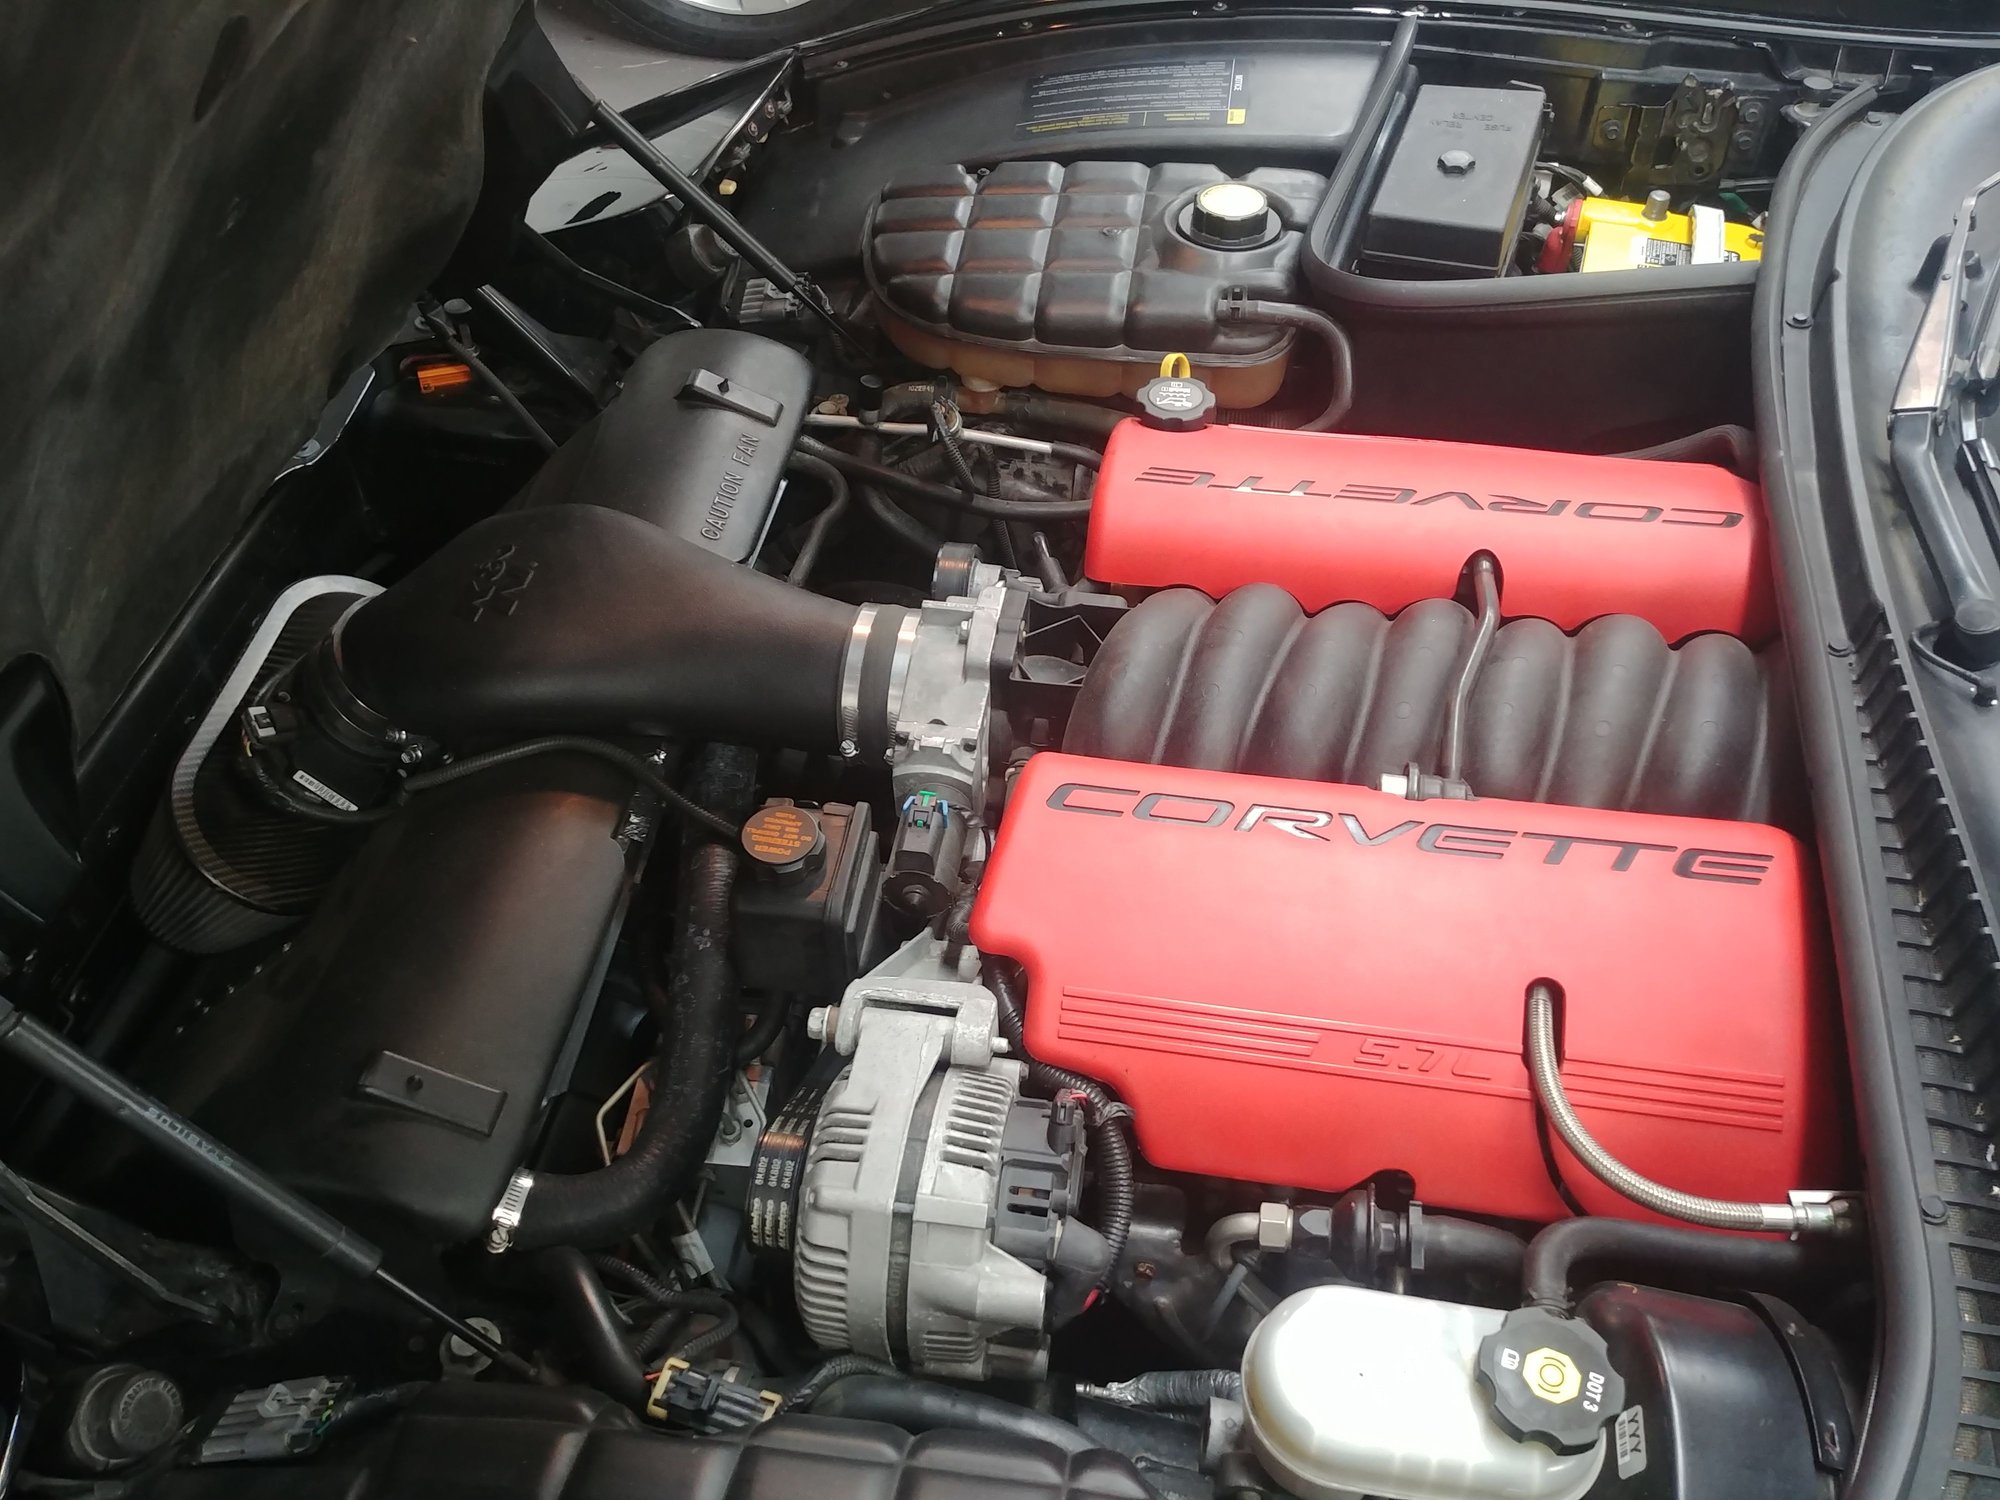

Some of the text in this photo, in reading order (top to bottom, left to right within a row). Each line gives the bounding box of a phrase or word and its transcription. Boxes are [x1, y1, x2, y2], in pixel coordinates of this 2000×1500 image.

[700, 432, 760, 541] CAUTION FAN
[1134, 466, 1745, 528] CORVETTE
[751, 834, 801, 848] STEERING
[753, 844, 792, 856] POWER
[1047, 782, 1775, 886] CORVETTE
[1354, 1038, 1491, 1081] 5.7L
[1582, 1371, 1605, 1413] DOT 3
